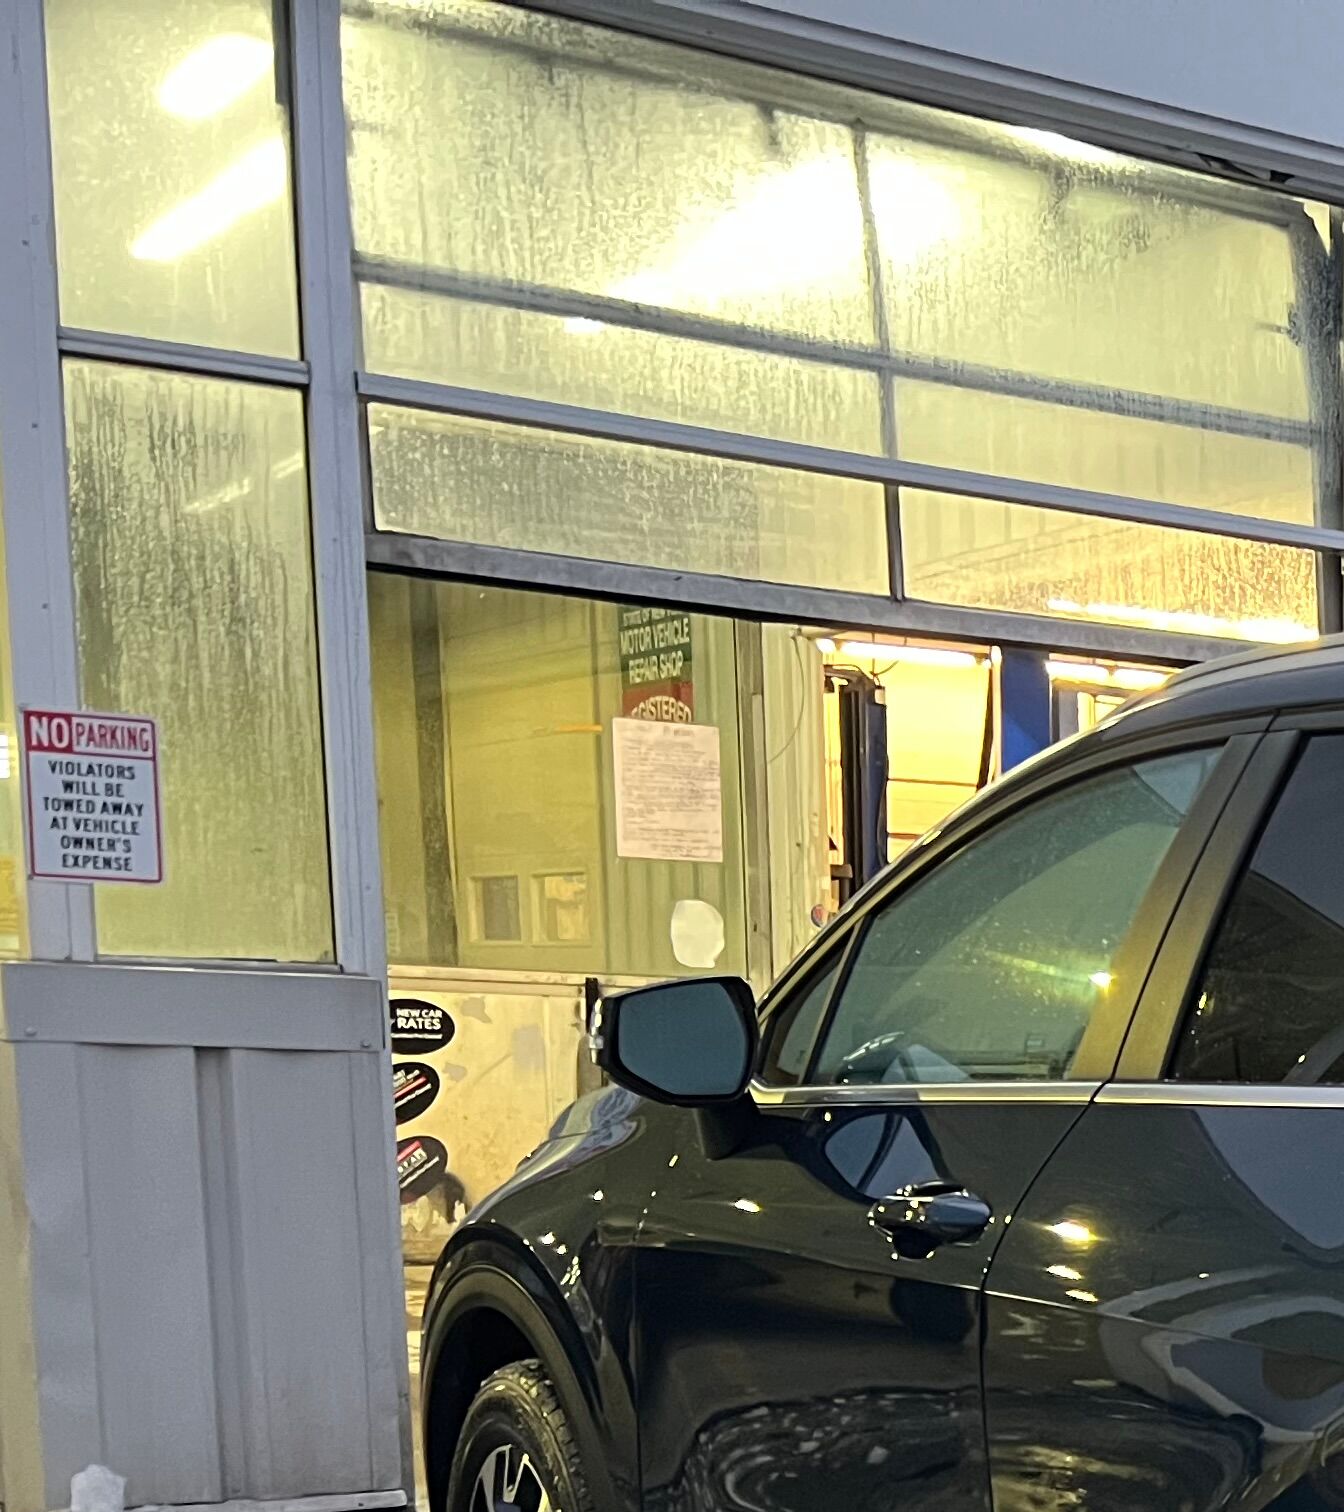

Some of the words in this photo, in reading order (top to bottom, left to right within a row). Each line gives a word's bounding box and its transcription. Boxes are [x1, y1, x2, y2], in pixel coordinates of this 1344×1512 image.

[620, 625, 652, 655] MOTOR
[652, 617, 690, 649] VEHICLE
[629, 655, 659, 685] REPAIR
[659, 650, 684, 680] SHOP
[29, 715, 71, 748] NO
[75, 721, 150, 753] PARKING
[48, 760, 136, 780] VIOLATORS
[61, 780, 99, 797] WILL
[105, 783, 125, 798] BE
[43, 797, 95, 815] TOWED
[100, 800, 144, 817] AWAY
[50, 817, 69, 831] AT
[72, 818, 140, 836] VEHICLE
[60, 835, 132, 853] OWNER'S
[62, 853, 133, 872] EXPENSE
[396, 1008, 420, 1018] NEW
[421, 1009, 442, 1018] CAR
[397, 1017, 441, 1030] RATES
